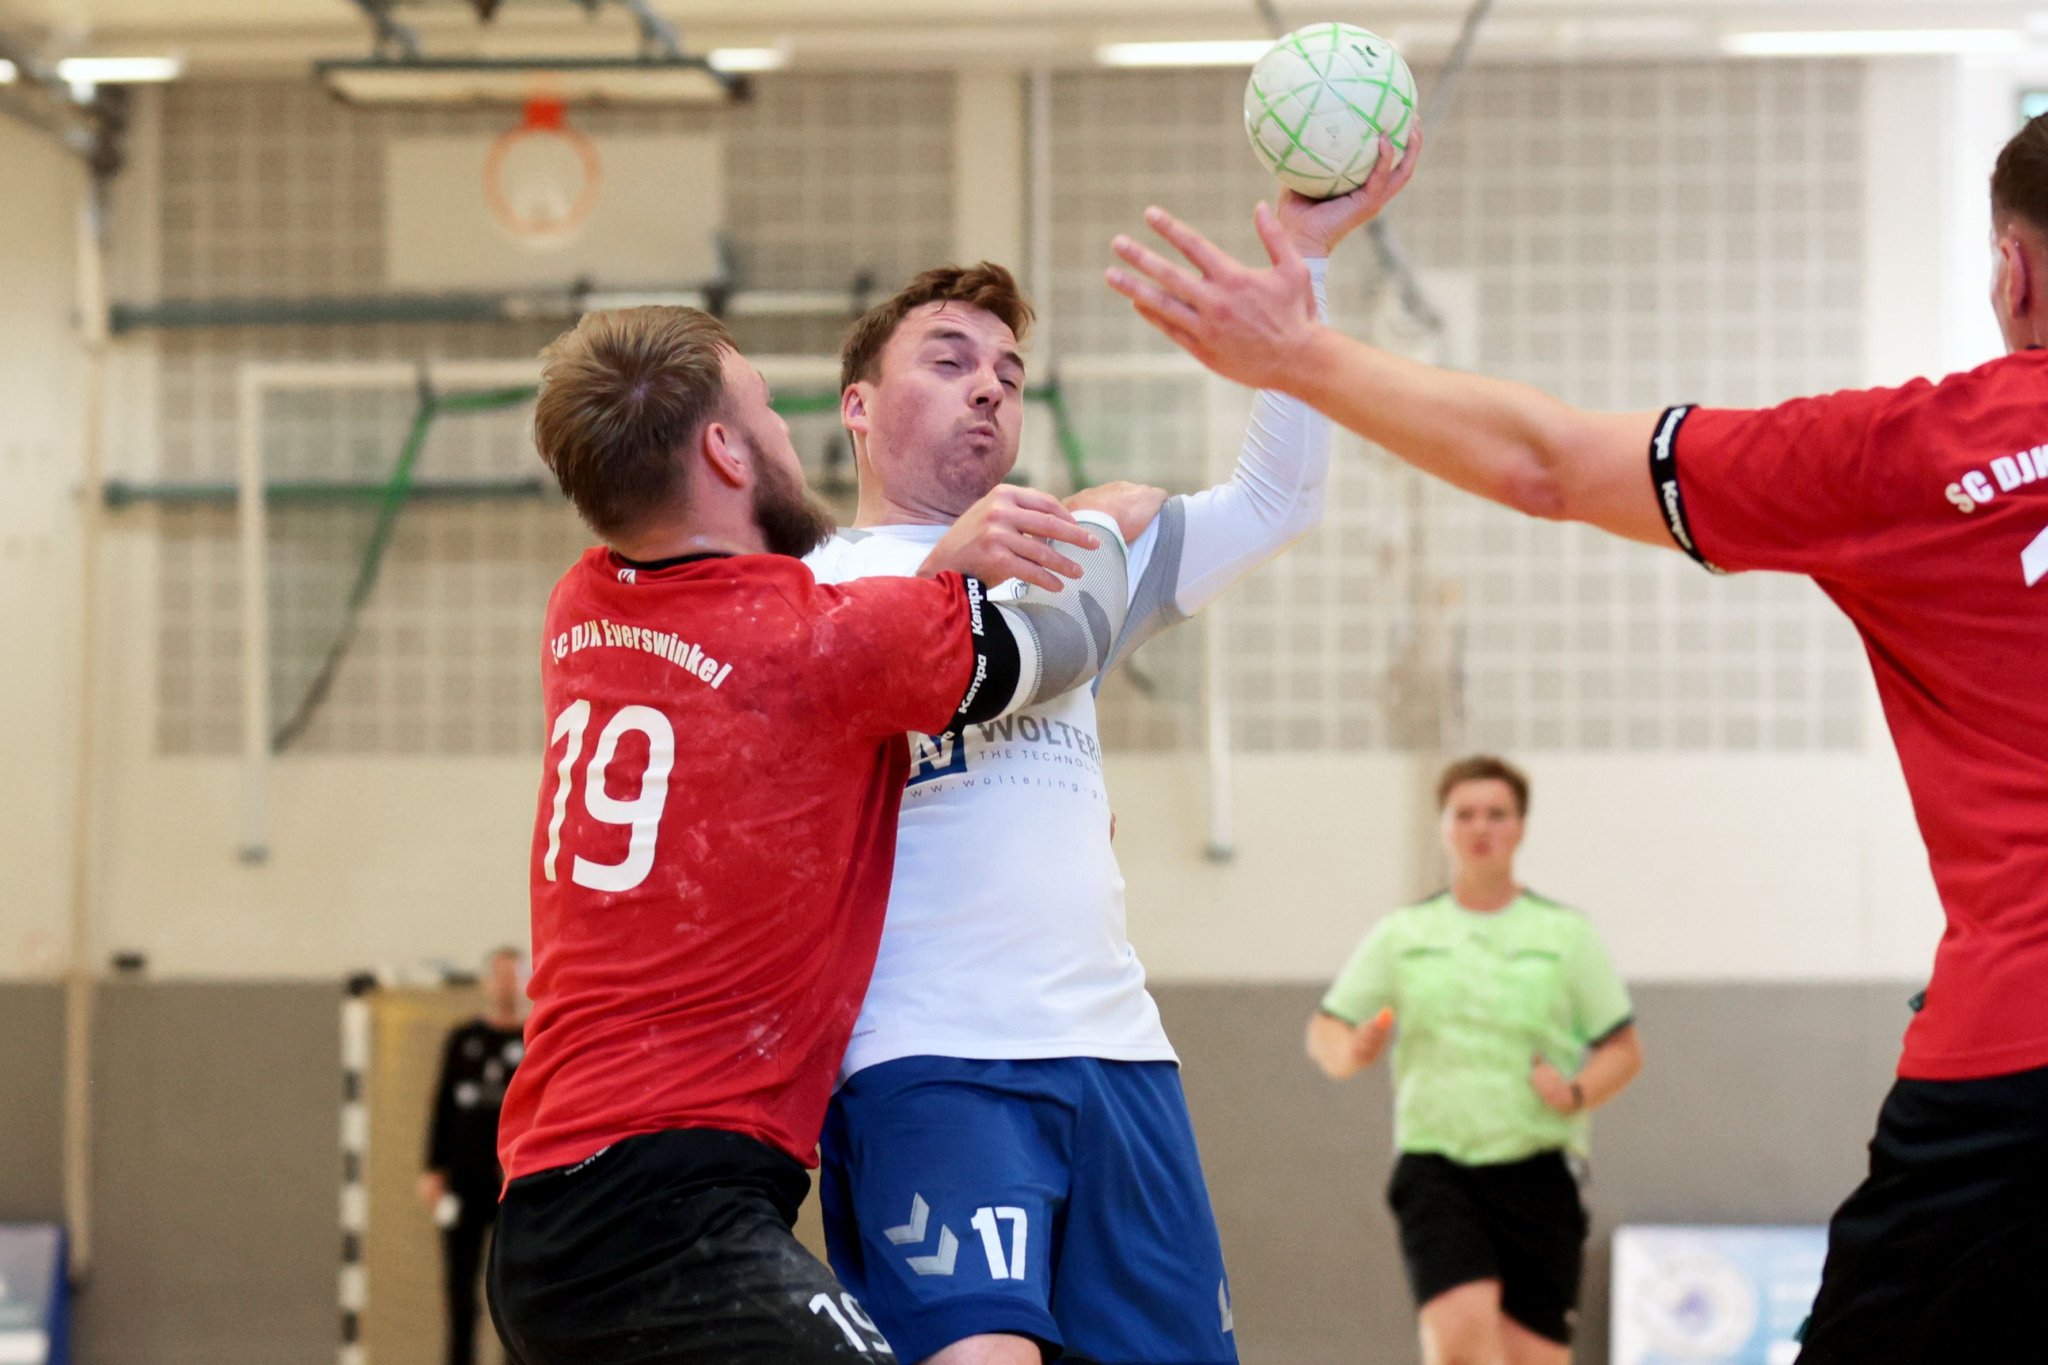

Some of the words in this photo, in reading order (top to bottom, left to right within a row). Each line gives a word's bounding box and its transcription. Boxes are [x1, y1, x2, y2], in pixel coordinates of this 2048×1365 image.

[1944, 469, 1995, 514] SC
[966, 577, 985, 637] Kempa
[601, 618, 733, 690] Everswinkel
[958, 653, 988, 714] Kempa
[979, 748, 1013, 760] THE
[544, 698, 675, 892] 19
[970, 1206, 1028, 1281] 17
[807, 1291, 894, 1354] 19
